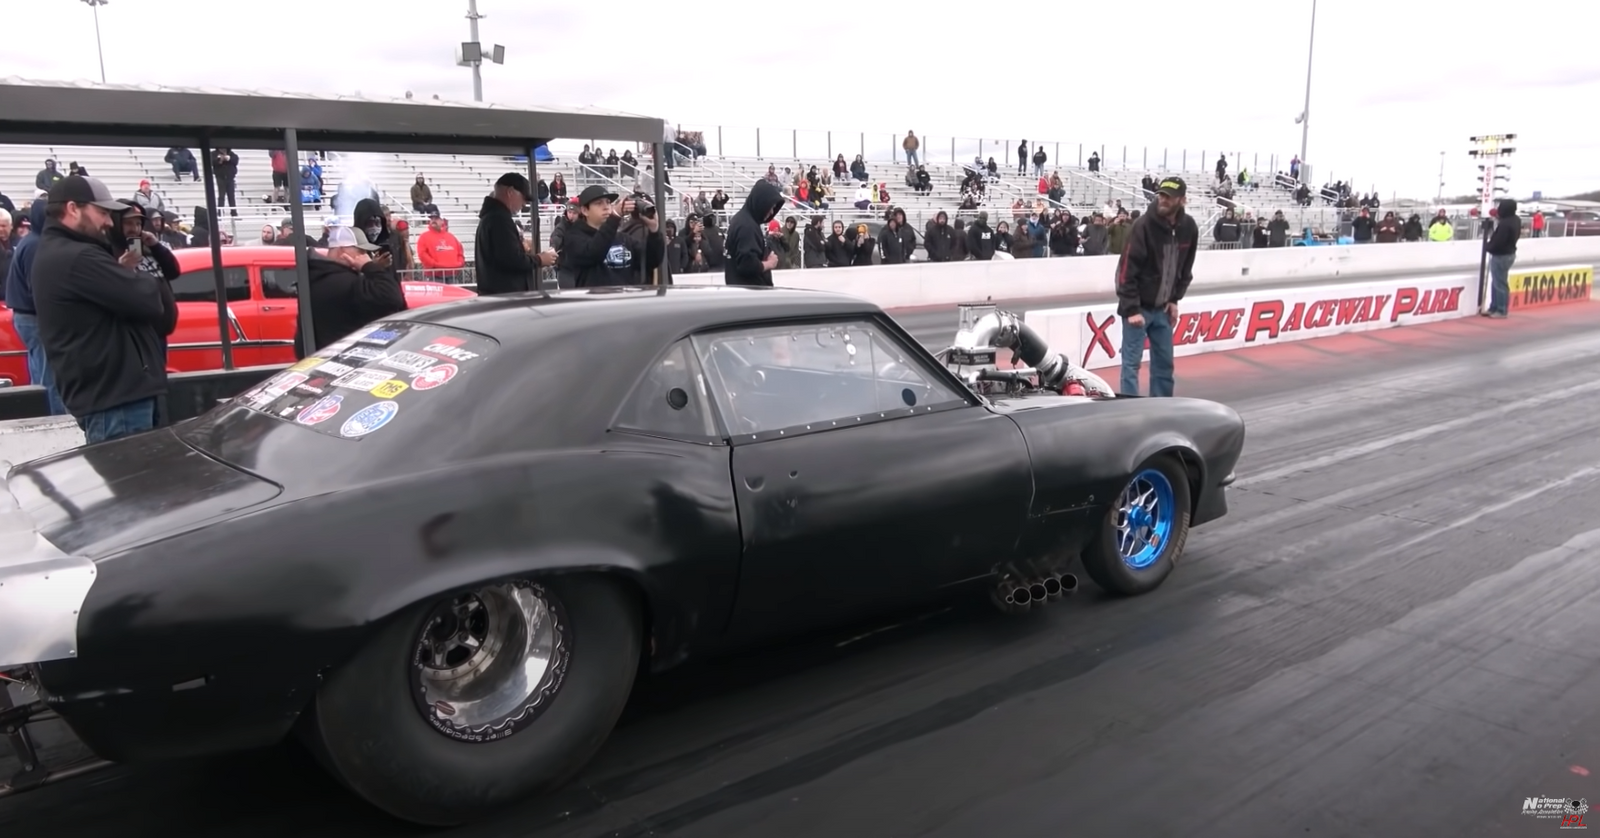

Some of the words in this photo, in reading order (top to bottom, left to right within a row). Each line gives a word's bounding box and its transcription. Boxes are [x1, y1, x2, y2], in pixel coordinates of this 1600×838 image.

[1523, 273, 1555, 305] TACO
[1558, 272, 1587, 301] CASA
[1082, 308, 1245, 369] XEME
[1245, 295, 1392, 342] RACEWAY
[1390, 286, 1465, 322] PARK
[423, 343, 480, 361] CHANCE
[380, 381, 402, 394] TMS
[429, 714, 482, 742] Specialties
[485, 728, 512, 741] Billet
